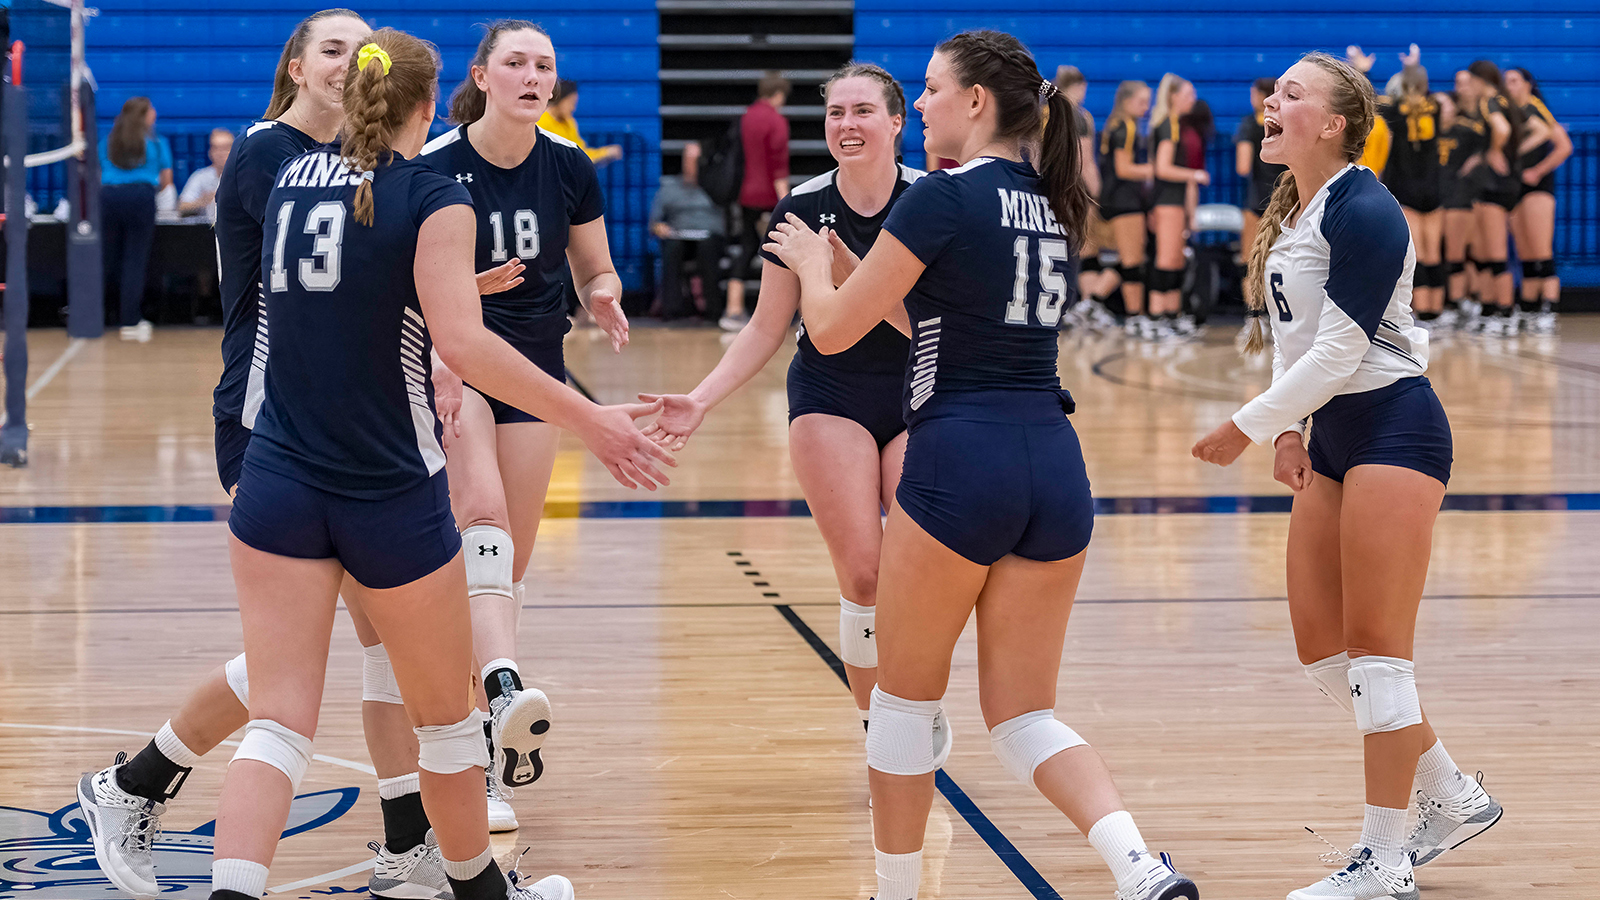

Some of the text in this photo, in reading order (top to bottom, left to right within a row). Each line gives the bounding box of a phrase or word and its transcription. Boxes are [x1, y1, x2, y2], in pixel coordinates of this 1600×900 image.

[489, 209, 540, 262] 18
[997, 188, 1069, 236] MINE
[270, 200, 347, 293] 13
[1004, 235, 1068, 327] 15
[1270, 272, 1293, 322] 6
